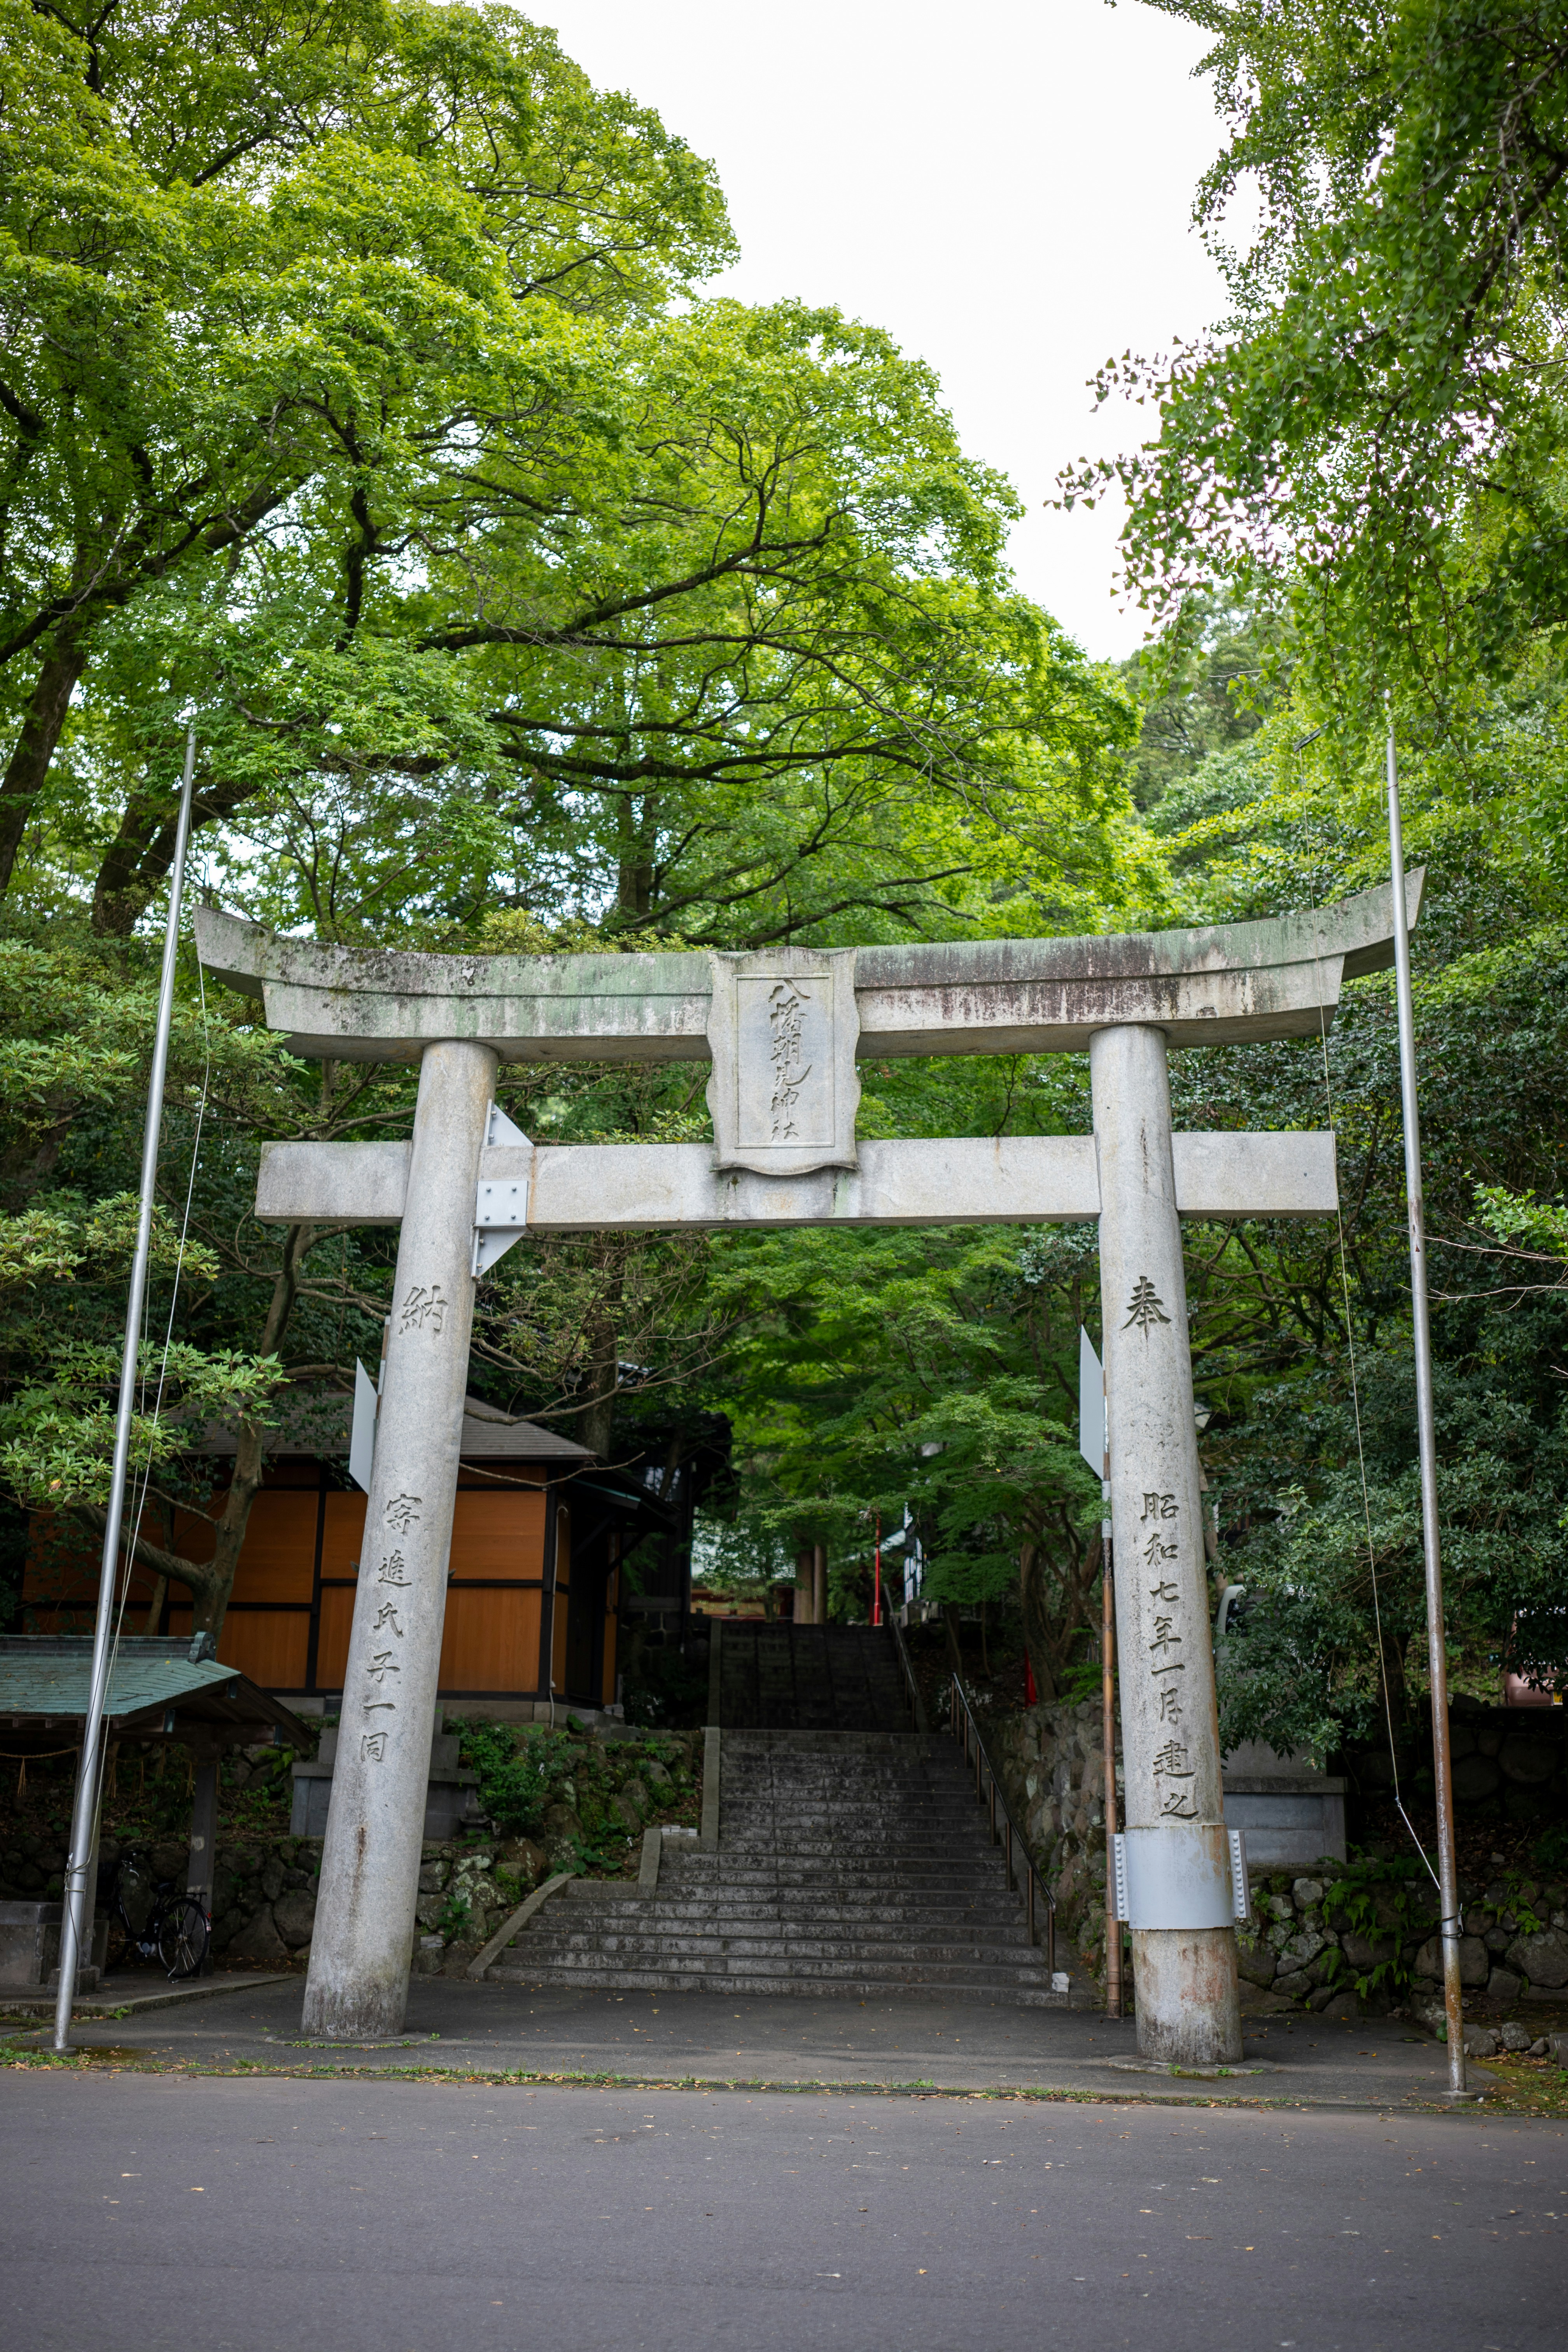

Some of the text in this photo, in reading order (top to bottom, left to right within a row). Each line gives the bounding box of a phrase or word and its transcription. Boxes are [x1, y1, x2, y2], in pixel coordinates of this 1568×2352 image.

[768, 979, 812, 1141] 八幡朝見神社
[399, 1284, 448, 1335] 納
[1120, 1275, 1172, 1340] 奉
[360, 1493, 423, 1763] 寄進氏子一同
[1140, 1492, 1199, 1821] 昭和七年一月建之
